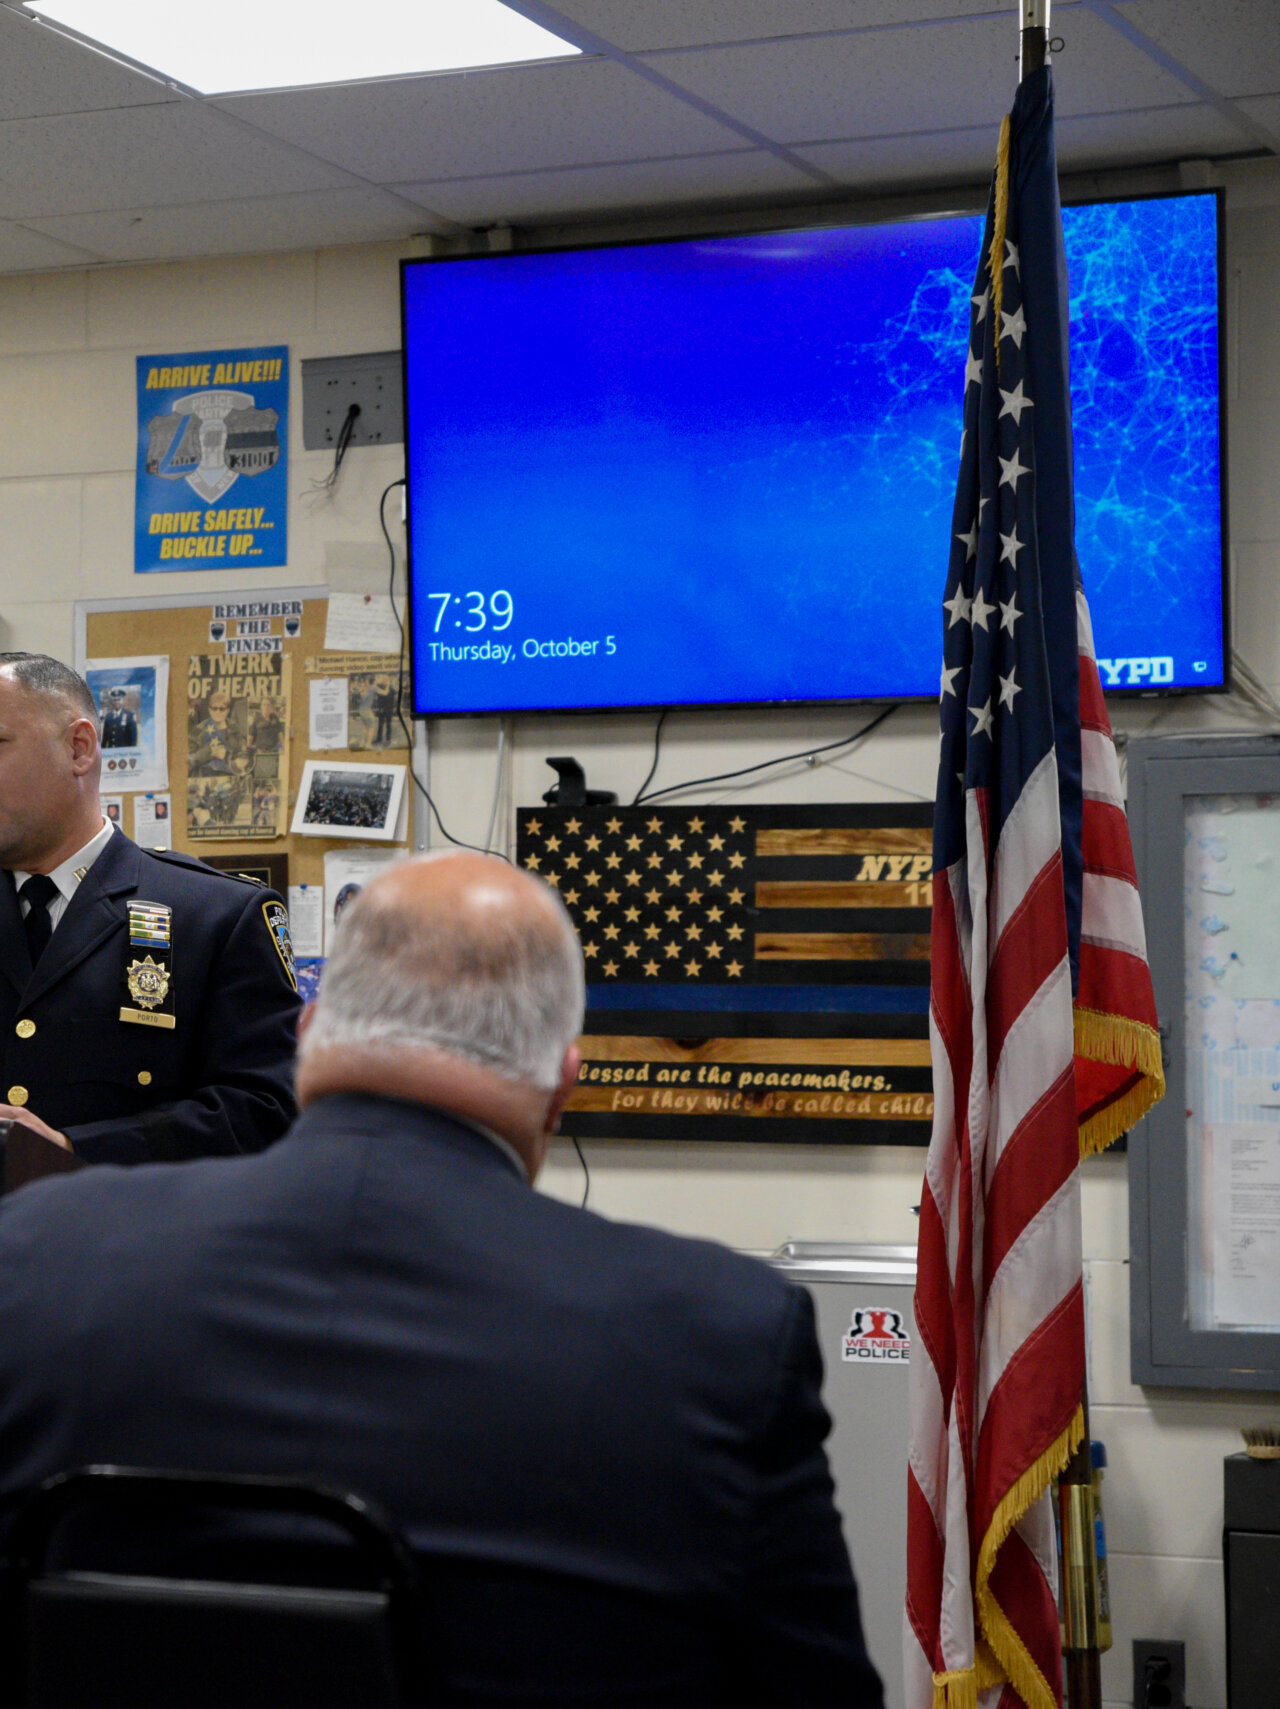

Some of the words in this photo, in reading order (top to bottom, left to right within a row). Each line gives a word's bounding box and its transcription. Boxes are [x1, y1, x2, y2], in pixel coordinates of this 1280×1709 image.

[146, 364, 211, 389] ARRIVE
[213, 359, 282, 385] ALIVE!!!
[192, 396, 234, 408] POLICE
[148, 511, 202, 535] DRIVE
[203, 508, 275, 532] SAFELY...
[160, 536, 227, 560] BUCKLE
[215, 600, 302, 619] REMEMBER
[428, 589, 514, 632] 7:39
[238, 619, 270, 635] THE
[227, 636, 282, 654] FINEST
[428, 640, 516, 664] Thursday,
[522, 636, 599, 658] October
[605, 635, 617, 655] 5
[189, 655, 202, 676] A
[207, 653, 274, 676] TWERK
[1096, 656, 1173, 685] YPD
[188, 677, 212, 699] OF
[217, 675, 281, 698] HEART
[856, 855, 933, 881] NYP
[578, 1063, 650, 1083] lessed
[656, 1067, 692, 1083] are
[697, 1066, 732, 1085] the
[737, 1067, 892, 1092] peacemakers,
[612, 1090, 643, 1110] for
[650, 1090, 699, 1112] they
[793, 1095, 871, 1114] called
[845, 1348, 910, 1359] POLICE
[846, 1339, 868, 1347] WE
